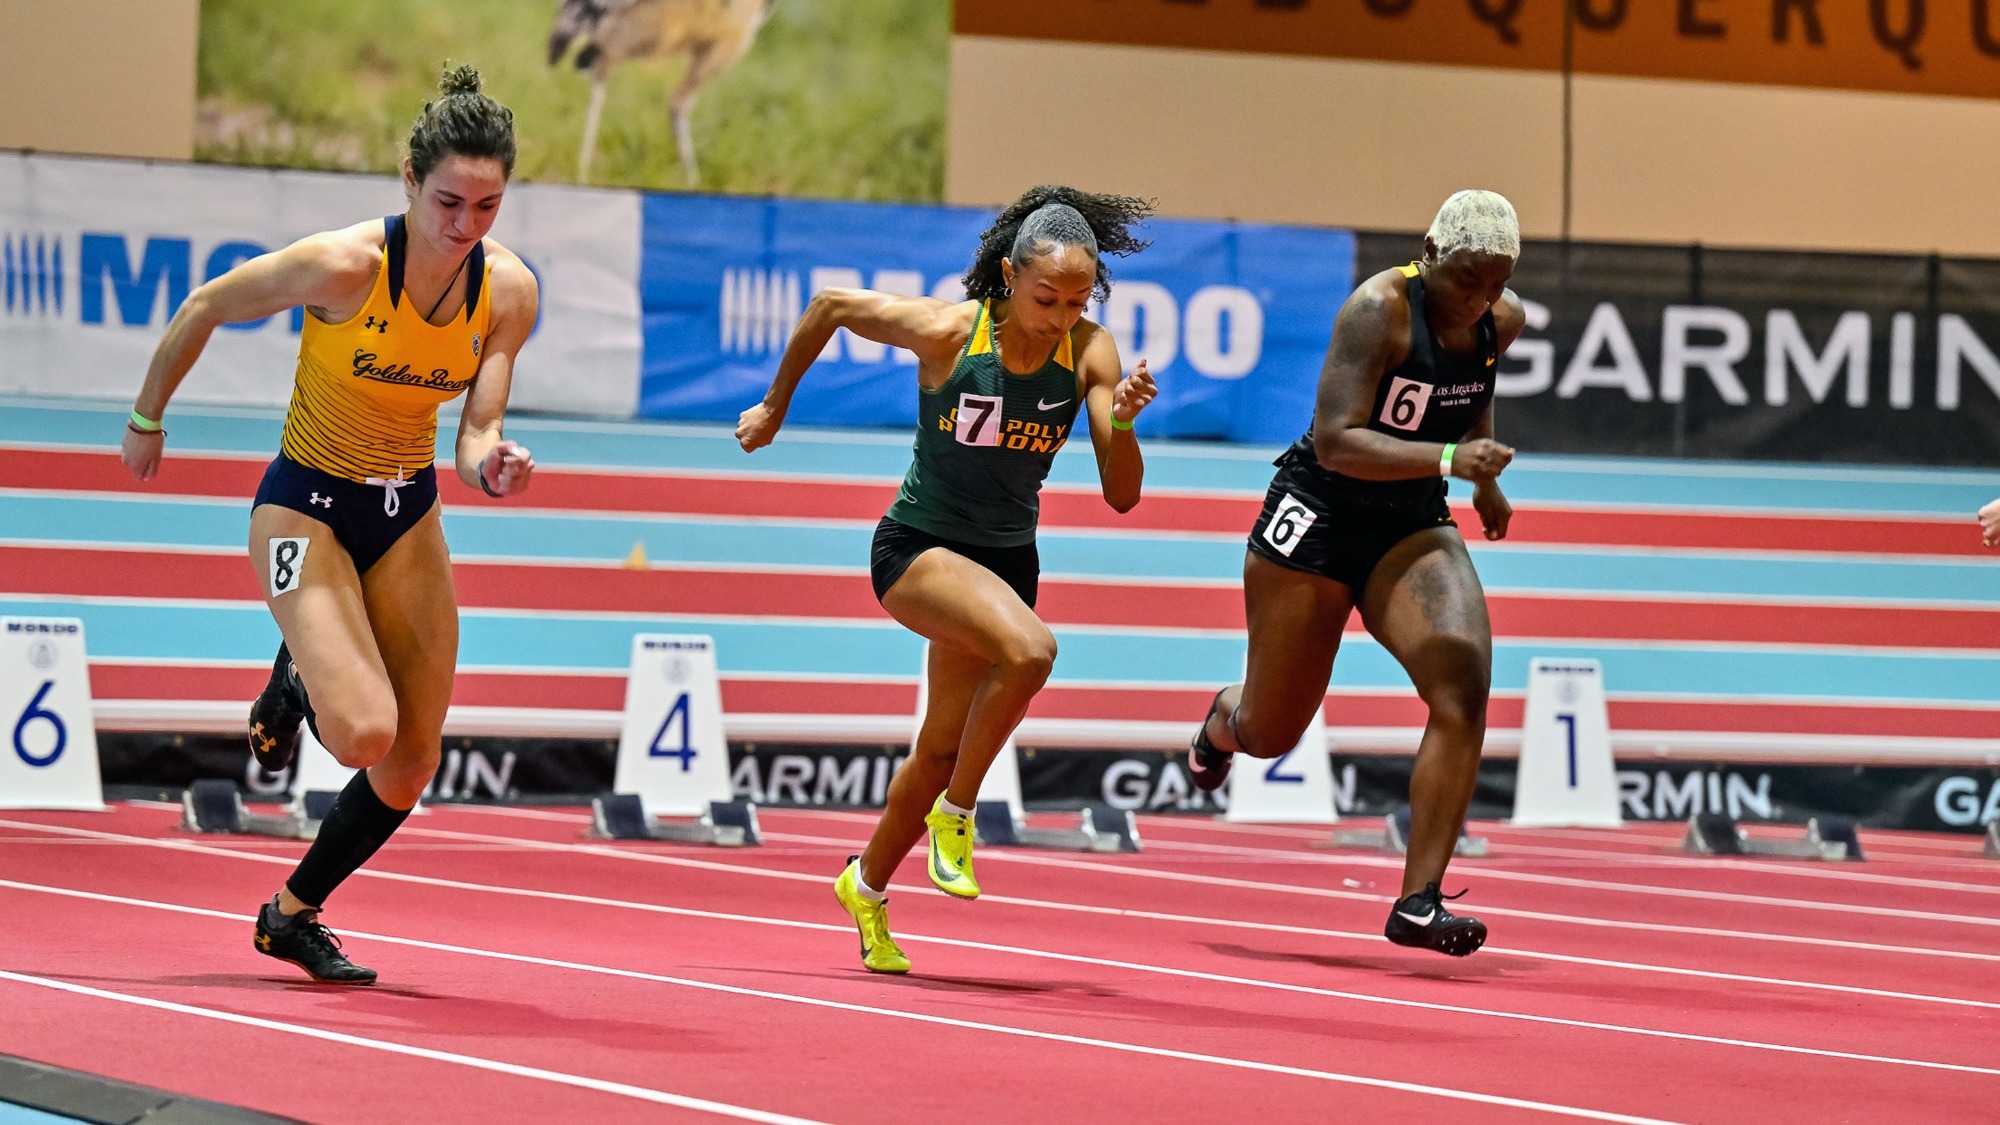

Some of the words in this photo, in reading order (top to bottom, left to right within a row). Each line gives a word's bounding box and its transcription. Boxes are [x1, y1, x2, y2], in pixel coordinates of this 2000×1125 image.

[809, 267, 1264, 380] MDO
[352, 349, 422, 383] Golden
[424, 368, 472, 391] Bear
[964, 399, 995, 443] 7
[1006, 419, 1067, 438] POLY
[1391, 384, 1422, 426] 6
[1272, 505, 1306, 546] 6
[275, 540, 299, 591] 8
[13, 679, 67, 768] 6
[648, 691, 698, 773] 4
[1556, 713, 1578, 789] 1
[1615, 770, 1772, 819] RMIN
